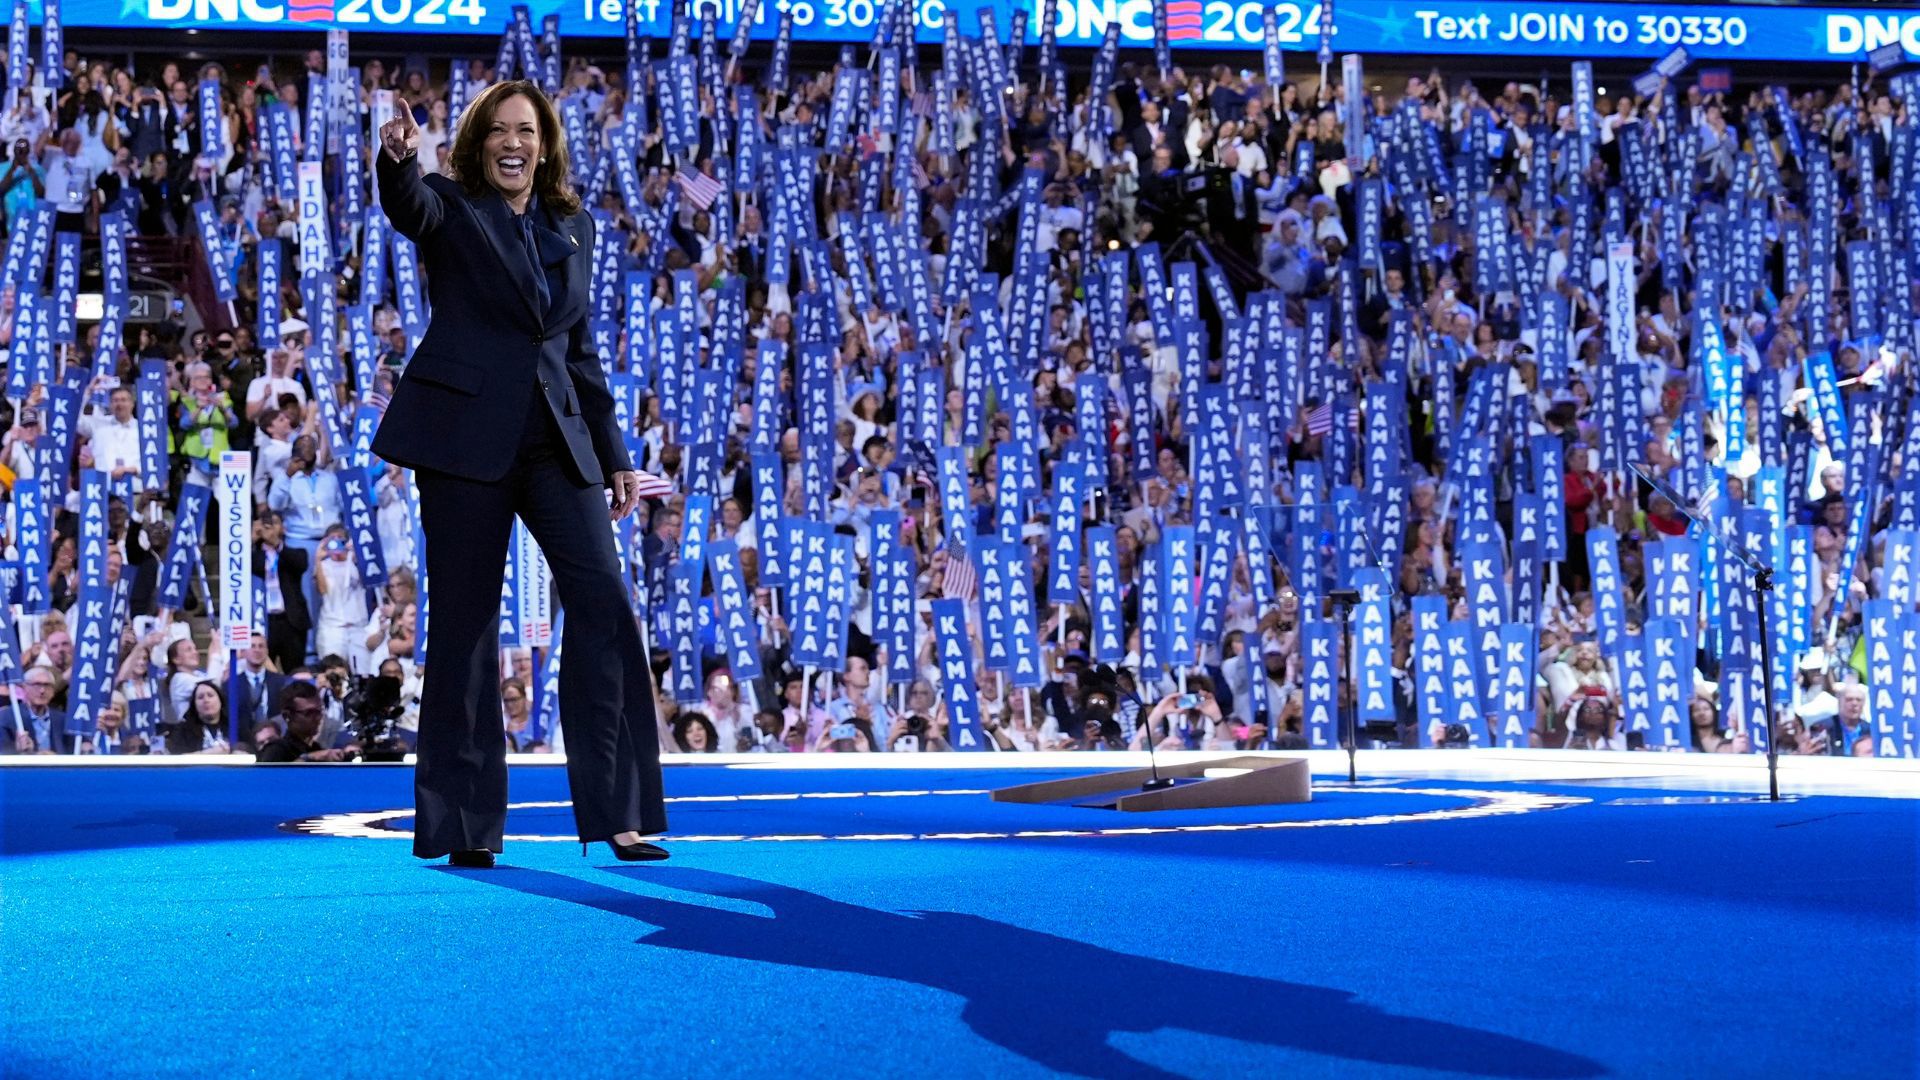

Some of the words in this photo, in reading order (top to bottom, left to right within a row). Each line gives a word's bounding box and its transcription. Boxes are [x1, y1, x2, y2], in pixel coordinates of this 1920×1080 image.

[13, 6, 25, 79] KAMALA
[45, 3, 59, 79] KAMALA
[148, 0, 284, 23] DNC
[336, 0, 486, 25] 2024
[516, 11, 537, 72] KAMALA
[546, 21, 557, 87] KAMALA
[703, 11, 714, 77] KAMALA
[773, 18, 790, 81] KAMALA
[824, 0, 946, 28] 300
[945, 16, 959, 81] KAMALA
[981, 14, 1003, 83] KAMALA
[1036, 0, 1156, 41] DNC
[1204, 2, 1338, 43] 2024
[1265, 12, 1281, 78] KAMALA
[1415, 10, 1491, 40] Text
[1499, 12, 1584, 42] JOIN
[1593, 15, 1629, 43] to
[1637, 15, 1747, 46] 30330
[203, 86, 217, 152] KAMALA
[657, 69, 680, 144] KAMALA
[680, 64, 696, 137] KAMALA
[712, 63, 728, 133] KAMALA
[830, 76, 851, 147] KAMALA
[883, 57, 895, 125] KAMALA
[935, 79, 949, 148] KAMALA
[973, 47, 995, 113] KAMALA
[1576, 69, 1591, 135] KAMALA
[273, 112, 296, 191] KAMALA
[308, 84, 324, 161] KAMALA
[566, 105, 590, 176] KAMALA
[739, 108, 754, 184] KAMALA
[1407, 106, 1426, 171] KAMALA
[1473, 116, 1485, 184] KAMALA
[1752, 120, 1778, 186] KAMALA
[346, 134, 358, 213] KAMALA
[612, 135, 639, 208] KAMALA
[780, 159, 807, 239] KAMALA
[859, 161, 880, 238] KAMALA
[981, 129, 996, 200] KAMALA
[1535, 133, 1548, 201] KAMALA
[1682, 134, 1697, 203] KAMALA
[1861, 146, 1874, 219] KAMALA
[5, 217, 29, 284] KAMAL
[28, 210, 50, 282] KAMAL
[105, 224, 122, 294] KAMAL
[201, 211, 231, 292] KAMALA
[365, 216, 380, 295] KAMALA
[840, 221, 867, 303] KAMALA
[872, 222, 898, 304] KAMALA
[945, 210, 967, 296] KAMALA
[1364, 188, 1377, 260] KAMALA
[1411, 201, 1429, 261] KAMAL
[1478, 212, 1490, 285] KAMALA
[1491, 207, 1509, 283] KAMALA
[1571, 204, 1587, 278] KAMALA
[1663, 204, 1679, 279] KAMALA
[1749, 208, 1763, 282] KAMALA
[57, 243, 74, 334] KAMALA
[263, 251, 276, 338] KAMALA
[397, 242, 418, 325] KAMALA
[910, 259, 931, 342] KAMALA
[1110, 261, 1123, 340] KAMALA
[1142, 253, 1171, 337] KAMALA
[1511, 243, 1537, 320] KAMALA
[1733, 229, 1747, 309] KAMALA
[1812, 265, 1825, 344] KAMALA
[1853, 251, 1871, 329] KAMALA
[12, 292, 33, 388] KAMALA
[321, 283, 333, 371] KAMALA
[630, 284, 646, 377] KAMALA
[712, 299, 730, 371] KAMAL
[1027, 274, 1047, 359] KAMALA
[1239, 304, 1262, 396] KAMALA
[1309, 312, 1324, 397] KAMALA
[1542, 300, 1556, 380] KAMALA
[1701, 307, 1727, 390] KAMALA
[310, 357, 344, 448] KAMALA
[660, 320, 677, 411] KAMALA
[680, 343, 695, 435] KAMALA
[756, 351, 776, 445] KAMALA
[968, 345, 983, 436] KAMALA
[1186, 332, 1200, 425] KAMALA
[1264, 359, 1282, 447] KAMALA
[1437, 360, 1450, 448] KAMALA
[1813, 364, 1846, 450] KAMALA
[142, 391, 160, 489] KAMALA
[1014, 393, 1036, 489] KAMALA
[1080, 385, 1099, 477] KAMALA
[1134, 382, 1151, 470] KAMALA
[1206, 397, 1238, 496] KAMALA
[1602, 365, 1615, 460] KAMALA
[1621, 374, 1640, 461] KAMALA
[1729, 365, 1743, 451] KAMALA
[1761, 380, 1777, 467] KAMALA
[1684, 411, 1701, 500] KAMALA
[1787, 443, 1807, 525] KAMALA
[345, 480, 382, 577] KAMALA
[759, 468, 781, 575] KAMALA
[1001, 456, 1017, 544] KAMAL
[1055, 477, 1076, 590] KAMALA
[1542, 451, 1560, 549] KAMALA
[20, 492, 43, 601] KAMALA
[226, 474, 245, 621] WISCONSIN
[1201, 529, 1231, 632] KAMALA
[715, 553, 754, 668] KAMALA
[801, 537, 825, 651] KAMALA
[823, 548, 845, 658] KAMALA
[892, 561, 911, 670] KAMALA
[982, 550, 1006, 658] KAMALA
[1007, 560, 1033, 674] KAMALA
[1094, 541, 1119, 650] KAMALA
[1142, 560, 1158, 668] KAMALA
[1171, 540, 1190, 651] KAMALA
[1593, 541, 1617, 644] KAMALA
[1790, 540, 1807, 642] KAMALA
[74, 601, 103, 720] KAMALA
[102, 581, 129, 693] KAMALA
[675, 578, 695, 690] KAMALA
[1362, 584, 1385, 710] KAMALA
[1421, 612, 1444, 736] KAMALA
[940, 616, 976, 747] KAMALA
[1309, 638, 1332, 746] KAMAL
[1655, 638, 1680, 746] KAMAL
[1871, 617, 1898, 757] KAMALA
